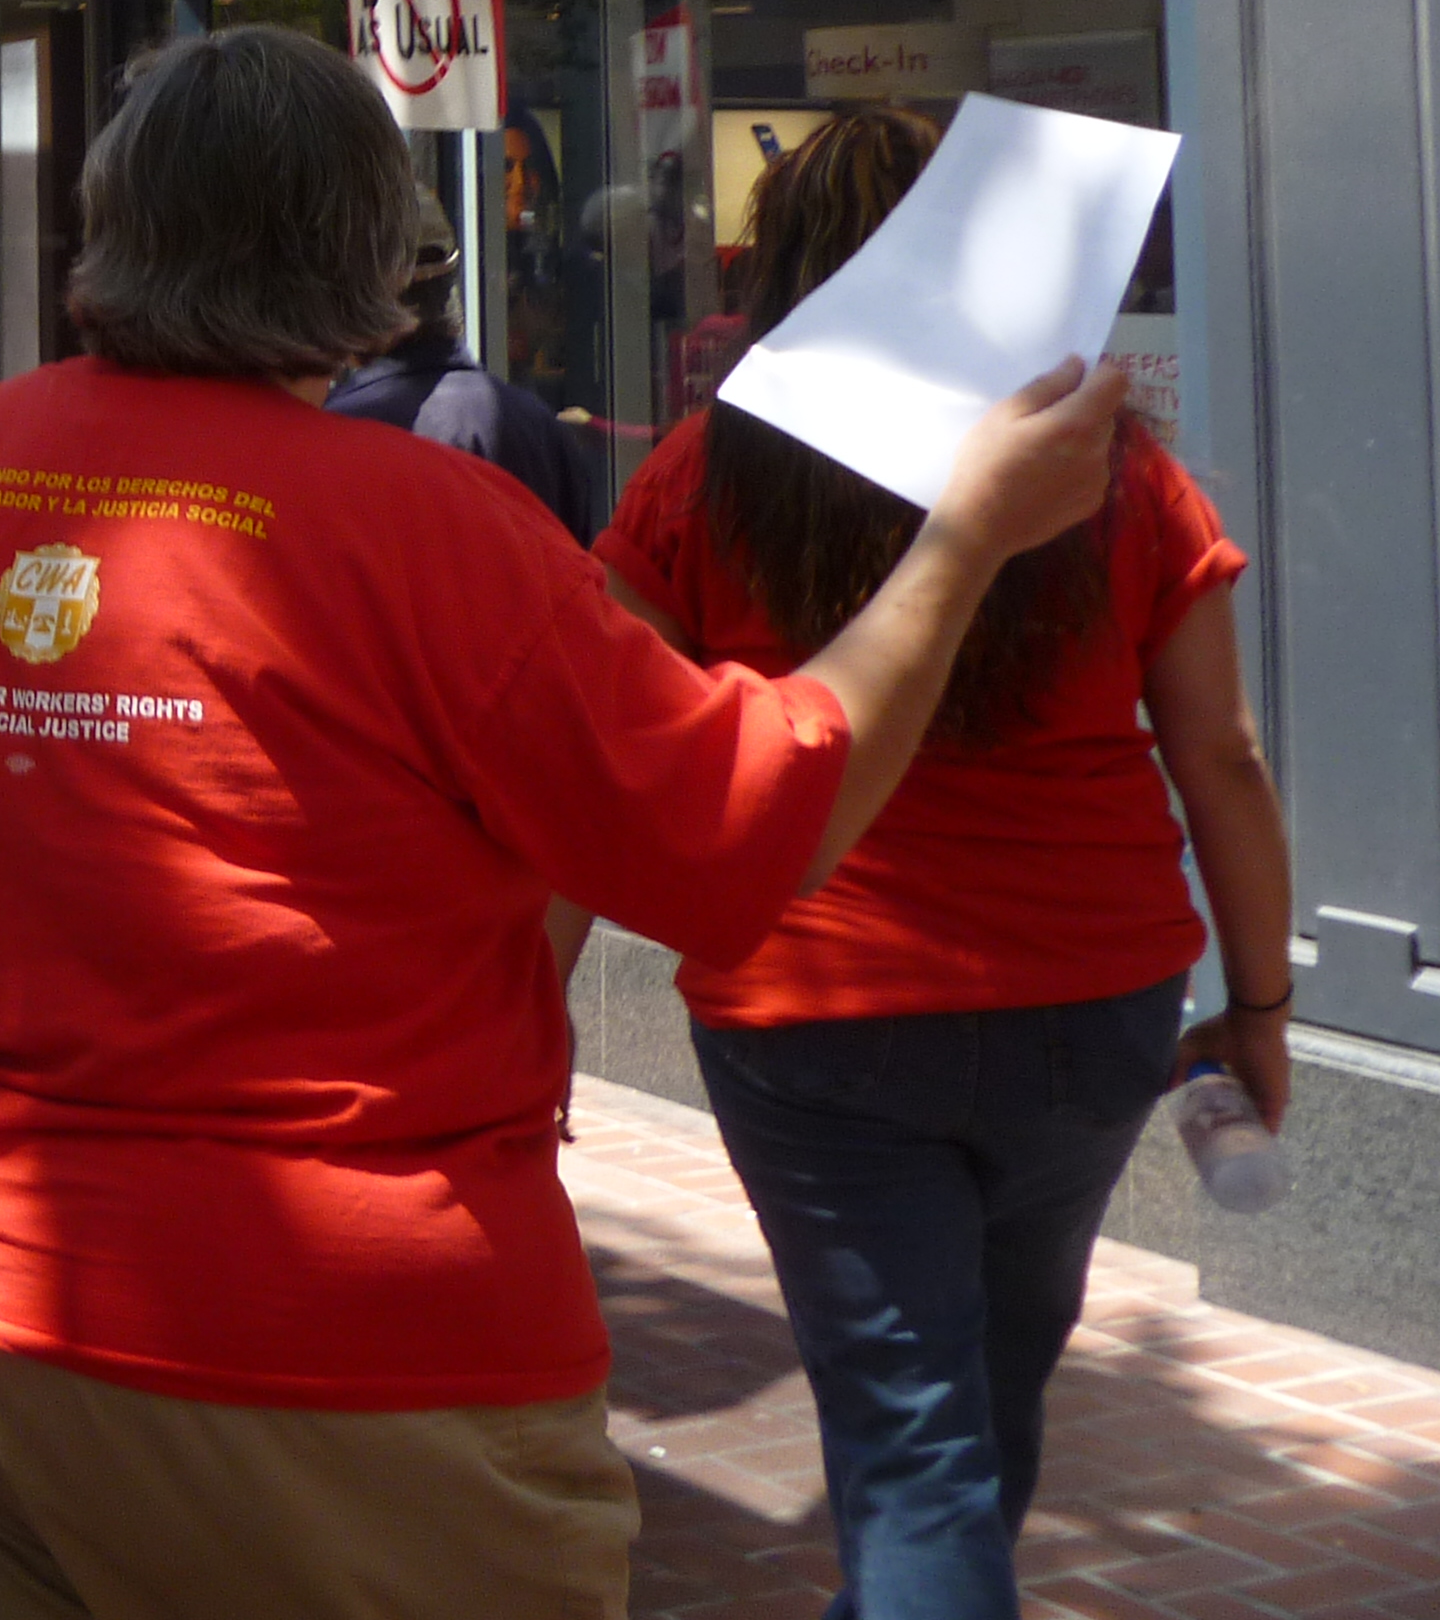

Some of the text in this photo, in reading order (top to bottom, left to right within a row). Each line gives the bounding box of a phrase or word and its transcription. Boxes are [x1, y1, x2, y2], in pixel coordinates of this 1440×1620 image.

[33, 470, 73, 490] POR
[75, 475, 113, 493] LOS
[116, 477, 227, 505] DERECHOS
[233, 490, 276, 519] DEL
[46, 495, 60, 513] Y
[63, 497, 86, 516] LA
[92, 499, 179, 520] JUSTICIA
[185, 505, 268, 540] SOCIAL
[14, 558, 88, 597] CWA
[11, 687, 111, 715] WORKERS'
[116, 693, 204, 722] RIGHTS
[38, 716, 130, 744] JUSTICE
